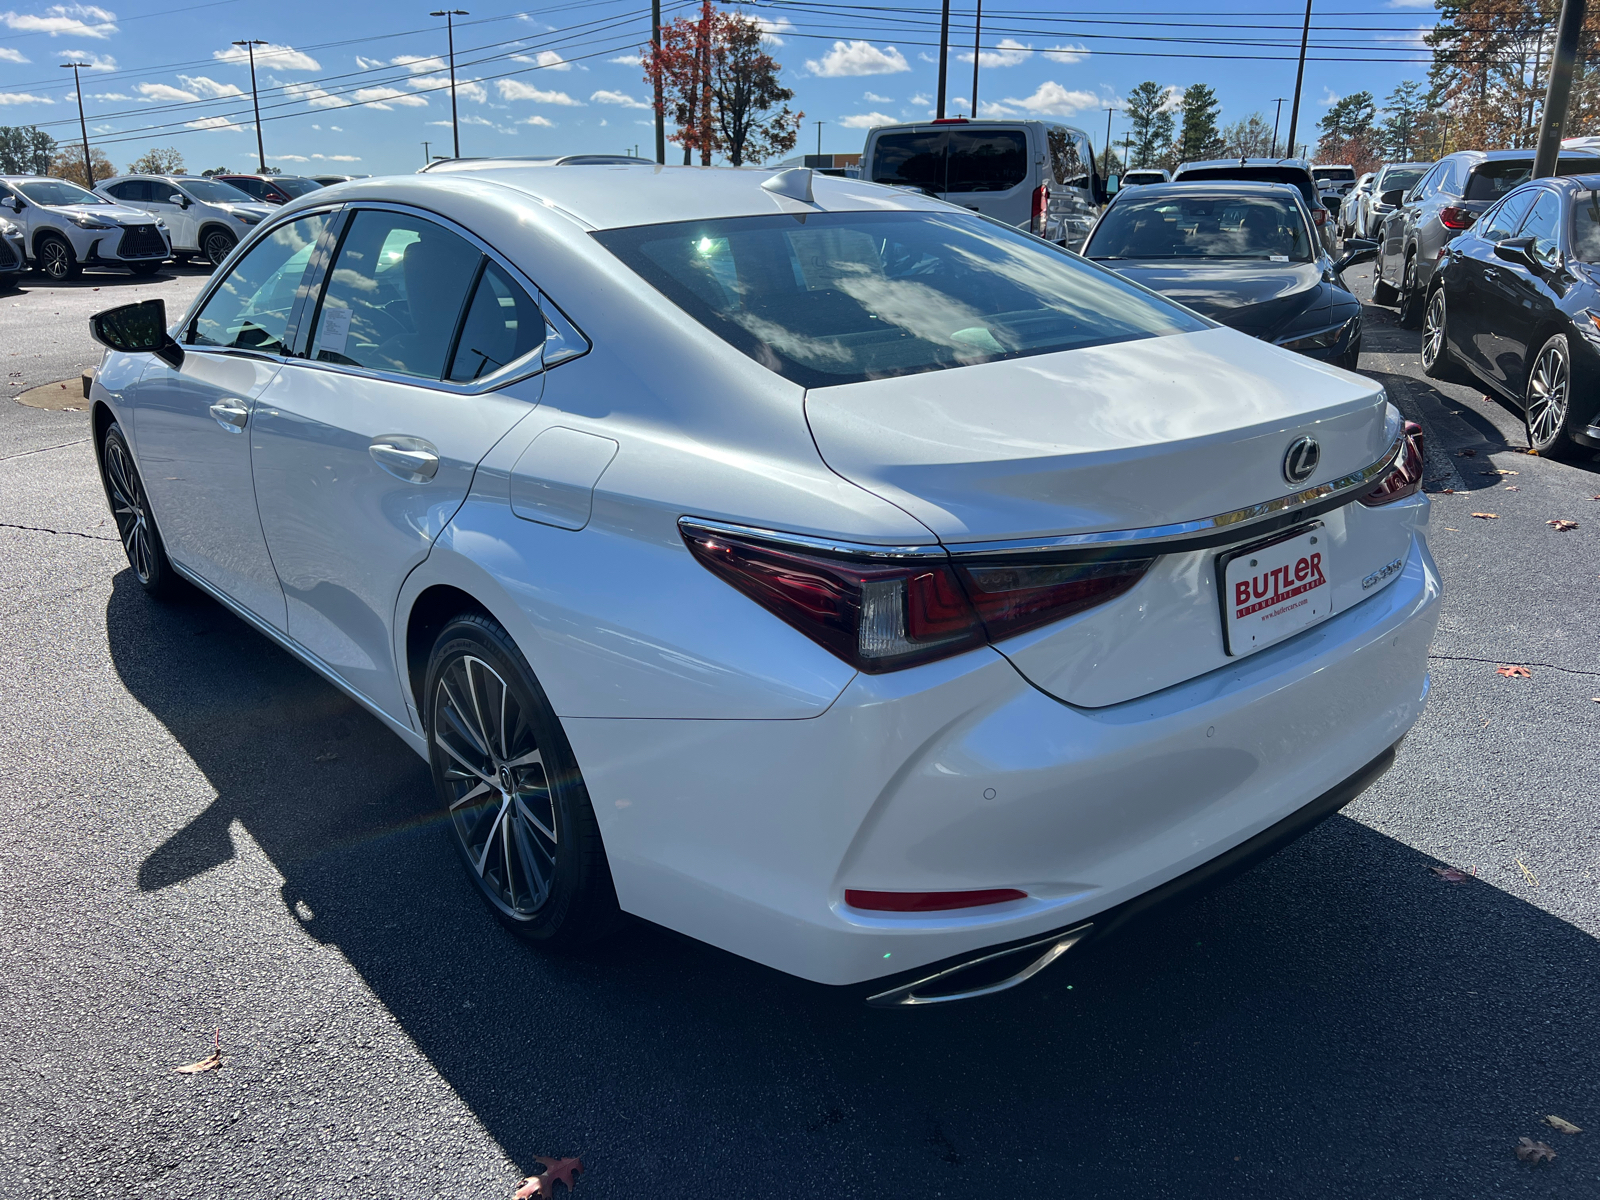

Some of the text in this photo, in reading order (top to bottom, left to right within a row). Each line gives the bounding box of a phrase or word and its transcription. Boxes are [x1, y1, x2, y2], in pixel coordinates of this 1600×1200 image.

[1237, 577, 1324, 617] AUTOMOTIVE GROUP
[1261, 599, 1308, 621] www.butlercars.com
